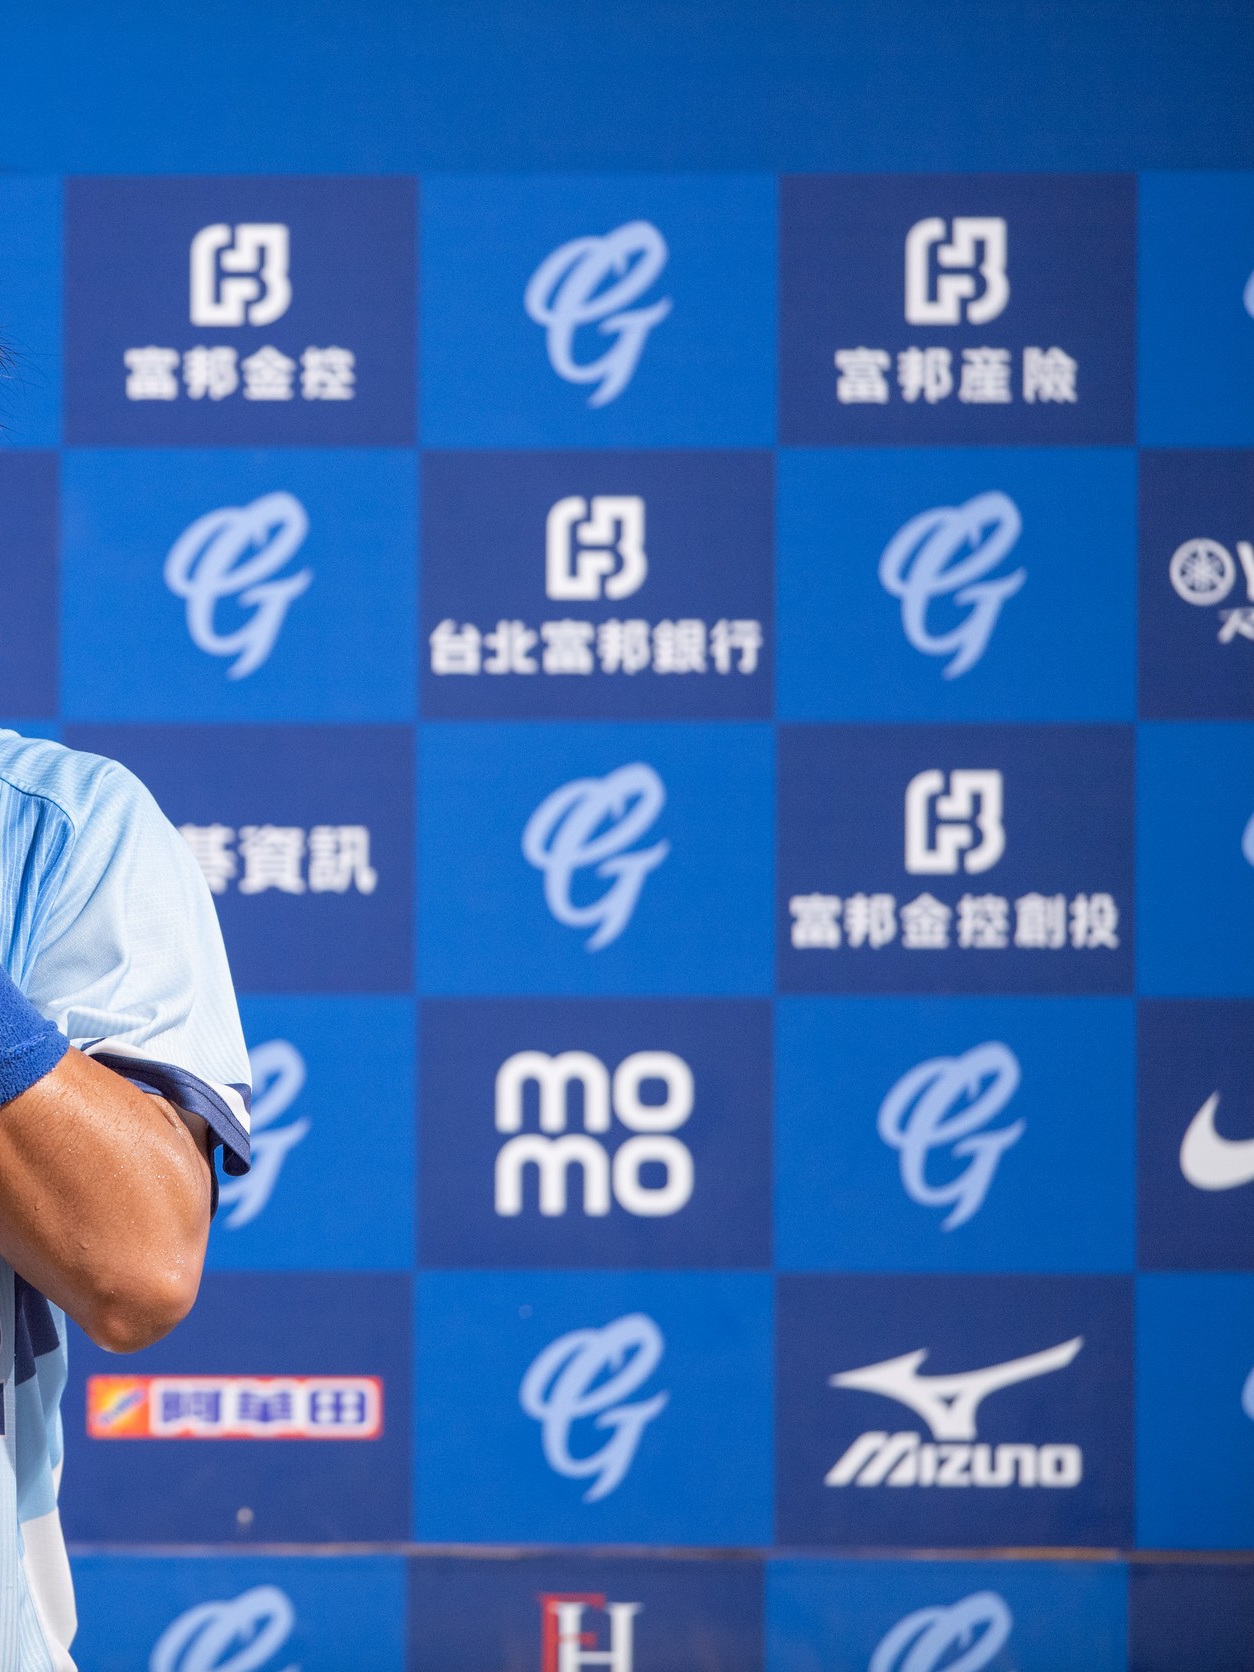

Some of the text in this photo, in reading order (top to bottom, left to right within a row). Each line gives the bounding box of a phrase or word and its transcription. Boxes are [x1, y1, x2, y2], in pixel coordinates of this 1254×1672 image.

[123, 345, 356, 401] 富邦金控
[429, 618, 764, 676] 台北富邦銀行
[788, 892, 1120, 949] 富邦金控創投
